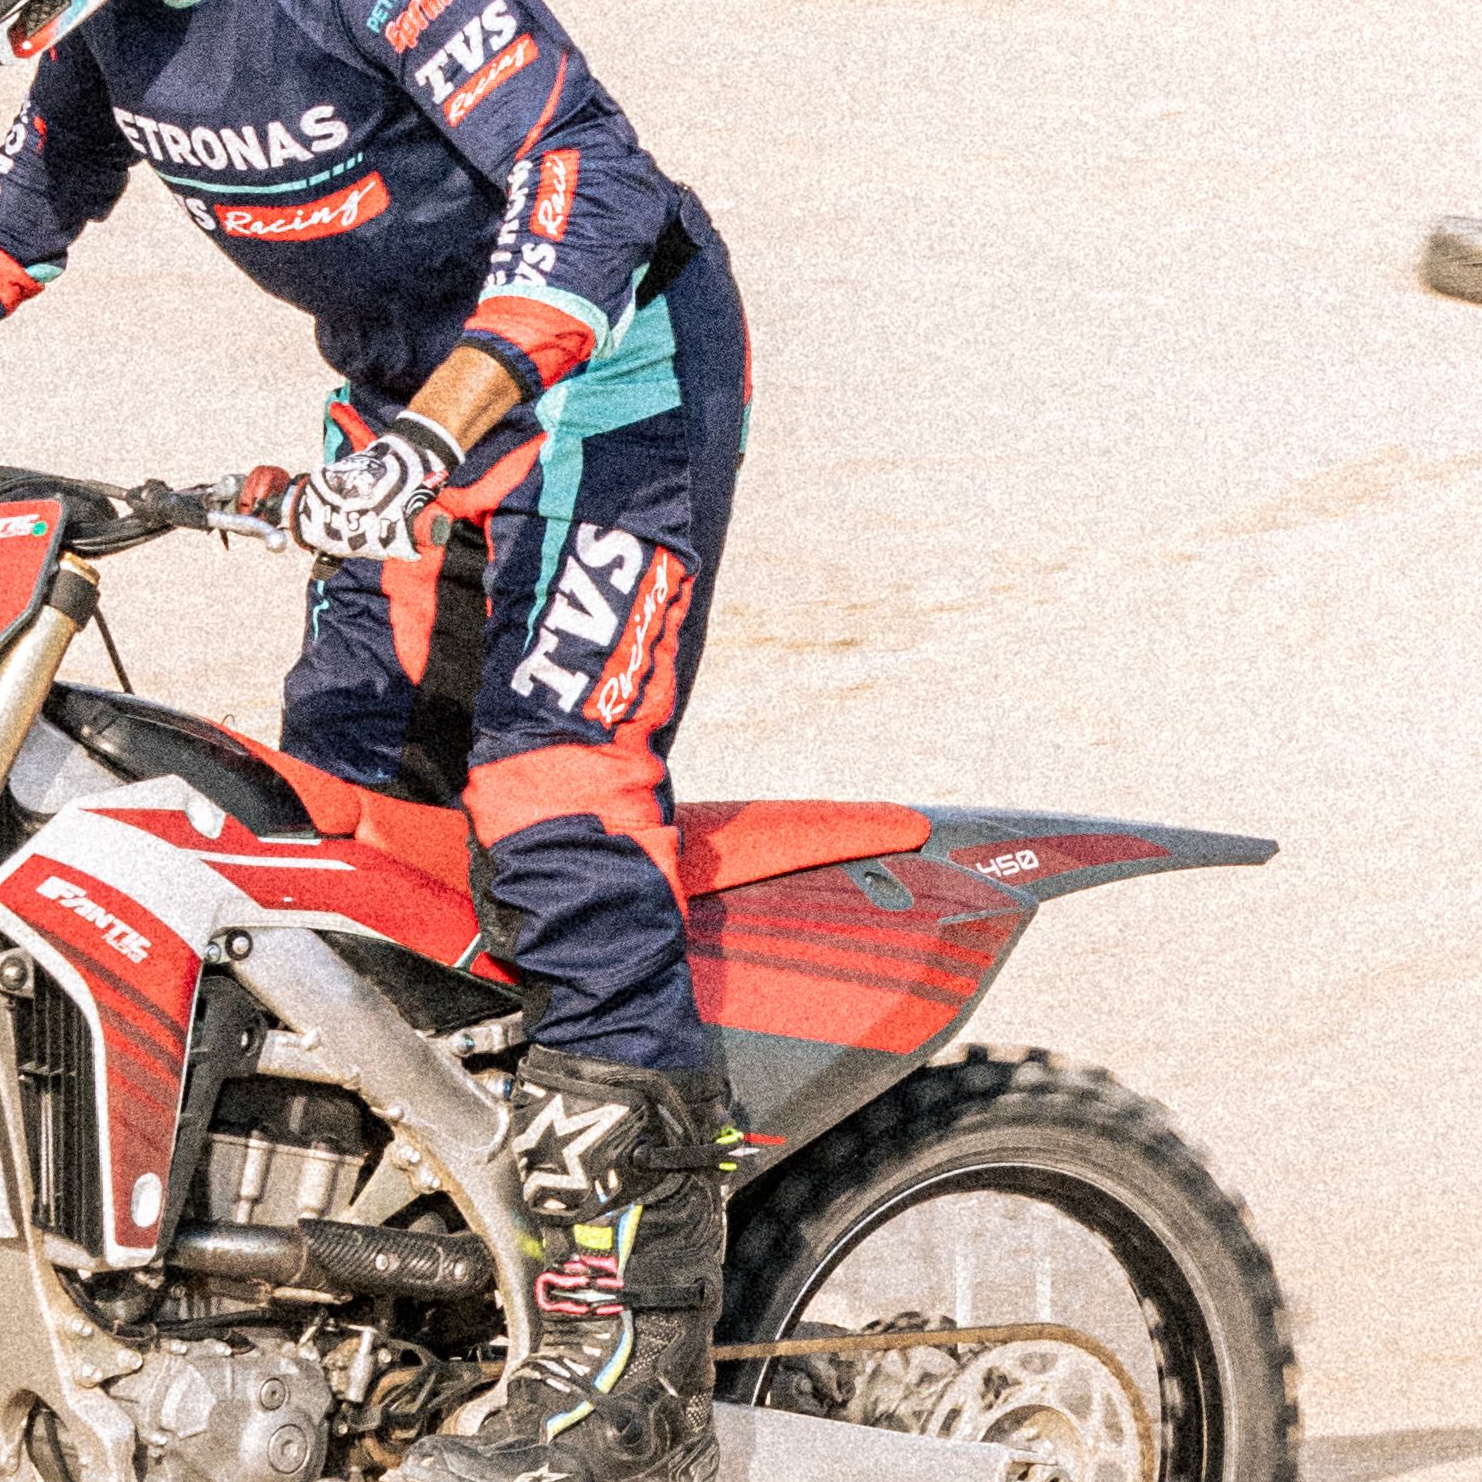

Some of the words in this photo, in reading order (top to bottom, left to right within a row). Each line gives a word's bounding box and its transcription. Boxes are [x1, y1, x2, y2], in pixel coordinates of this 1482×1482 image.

[449, 38, 530, 122] Racing
[113, 105, 349, 170] ETRONAS
[225, 180, 375, 235] Racing
[514, 243, 556, 286] VS
[511, 522, 643, 712] TVS
[597, 553, 668, 723] Racing
[976, 850, 1039, 877] 450
[36, 875, 152, 959] FANTIC
